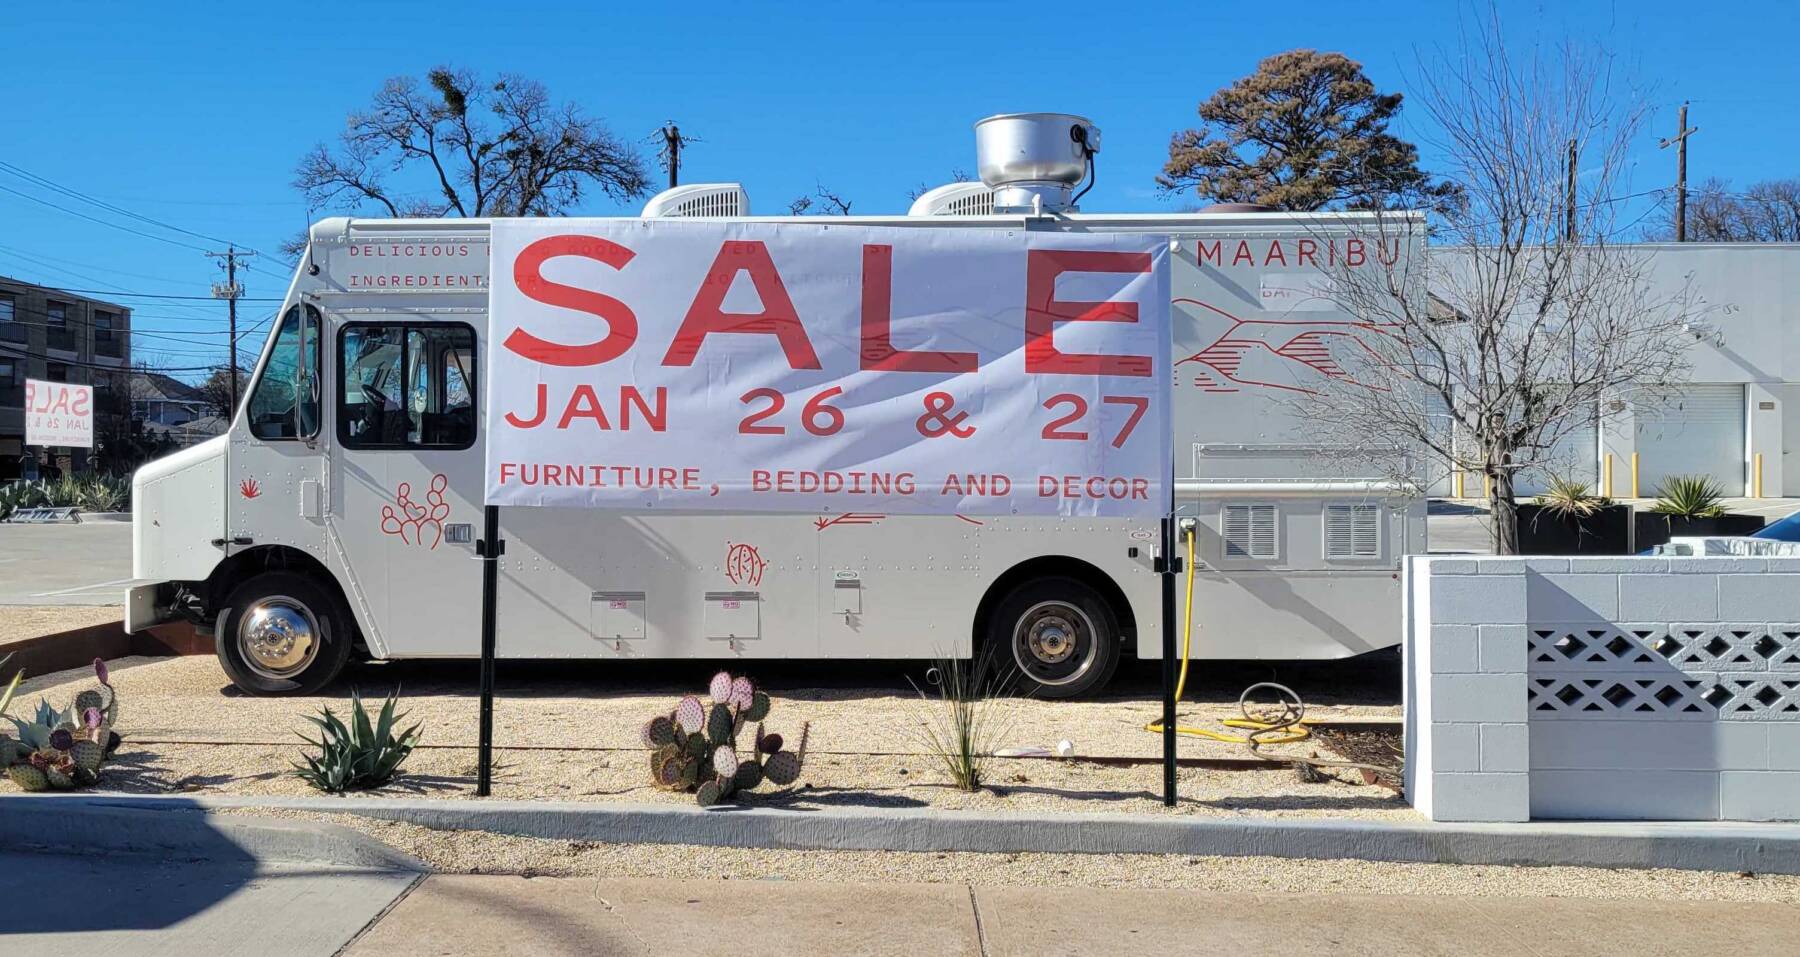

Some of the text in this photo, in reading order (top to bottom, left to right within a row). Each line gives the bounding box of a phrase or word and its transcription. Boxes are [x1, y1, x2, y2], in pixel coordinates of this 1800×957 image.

[350, 245, 469, 256] DELICIOUS
[1197, 239, 1400, 267] MAARIBU
[502, 234, 1153, 377] SALE
[504, 383, 1149, 449] JAN 26 & 27
[499, 463, 1150, 500] FURNITURE, BEDDING AND DECOR
